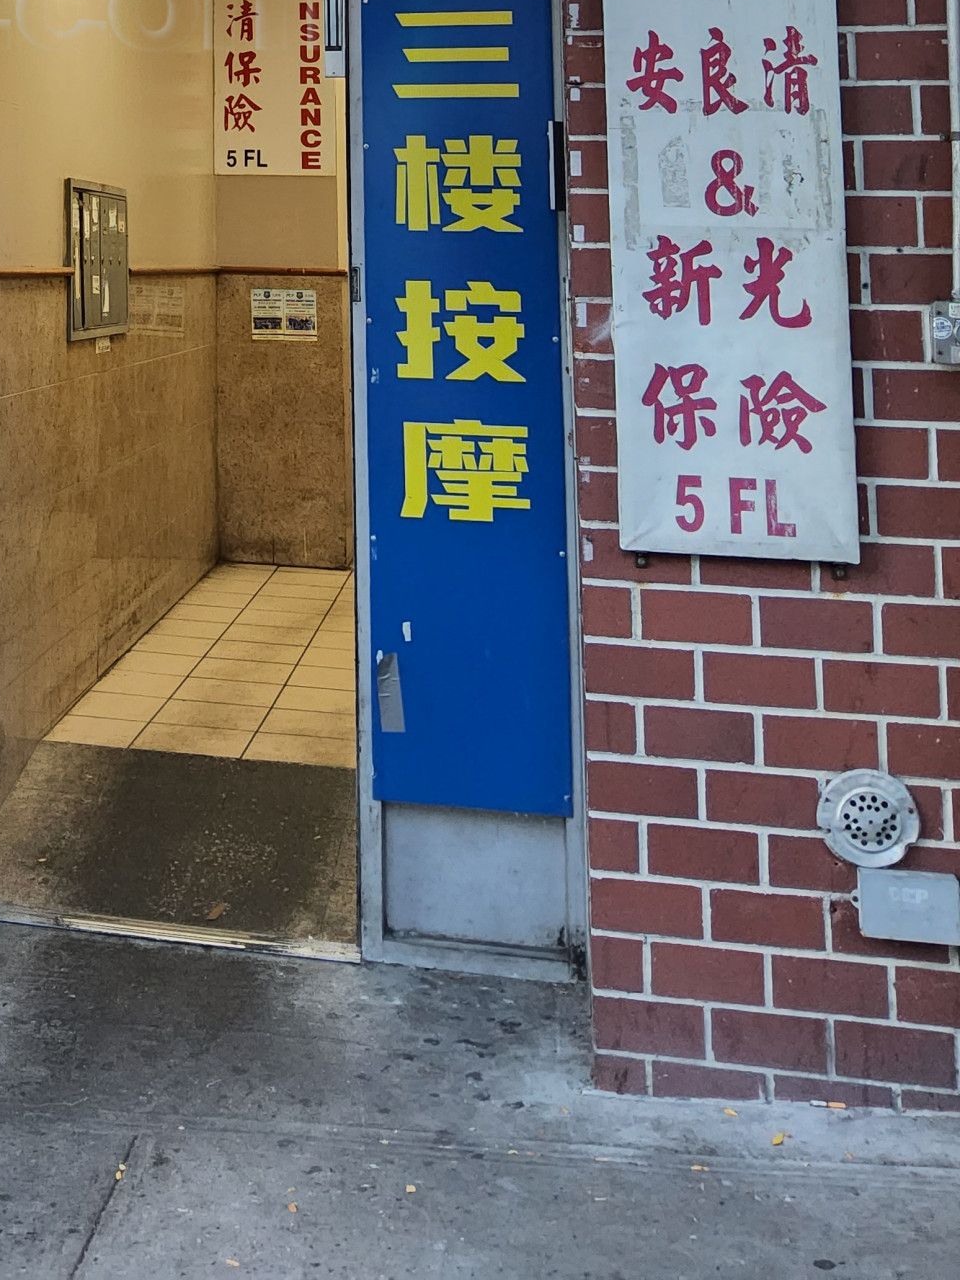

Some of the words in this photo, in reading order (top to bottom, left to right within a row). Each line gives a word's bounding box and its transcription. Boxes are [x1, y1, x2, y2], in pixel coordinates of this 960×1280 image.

[626, 25, 818, 116] 安良清
[227, 150, 237, 168] 5
[244, 149, 268, 167] FL
[704, 149, 759, 217] &
[392, 10, 531, 522] 三楼按摩
[641, 235, 812, 329] 新光
[640, 362, 827, 454] 保險
[675, 474, 705, 533] 5
[729, 477, 797, 538] FL
